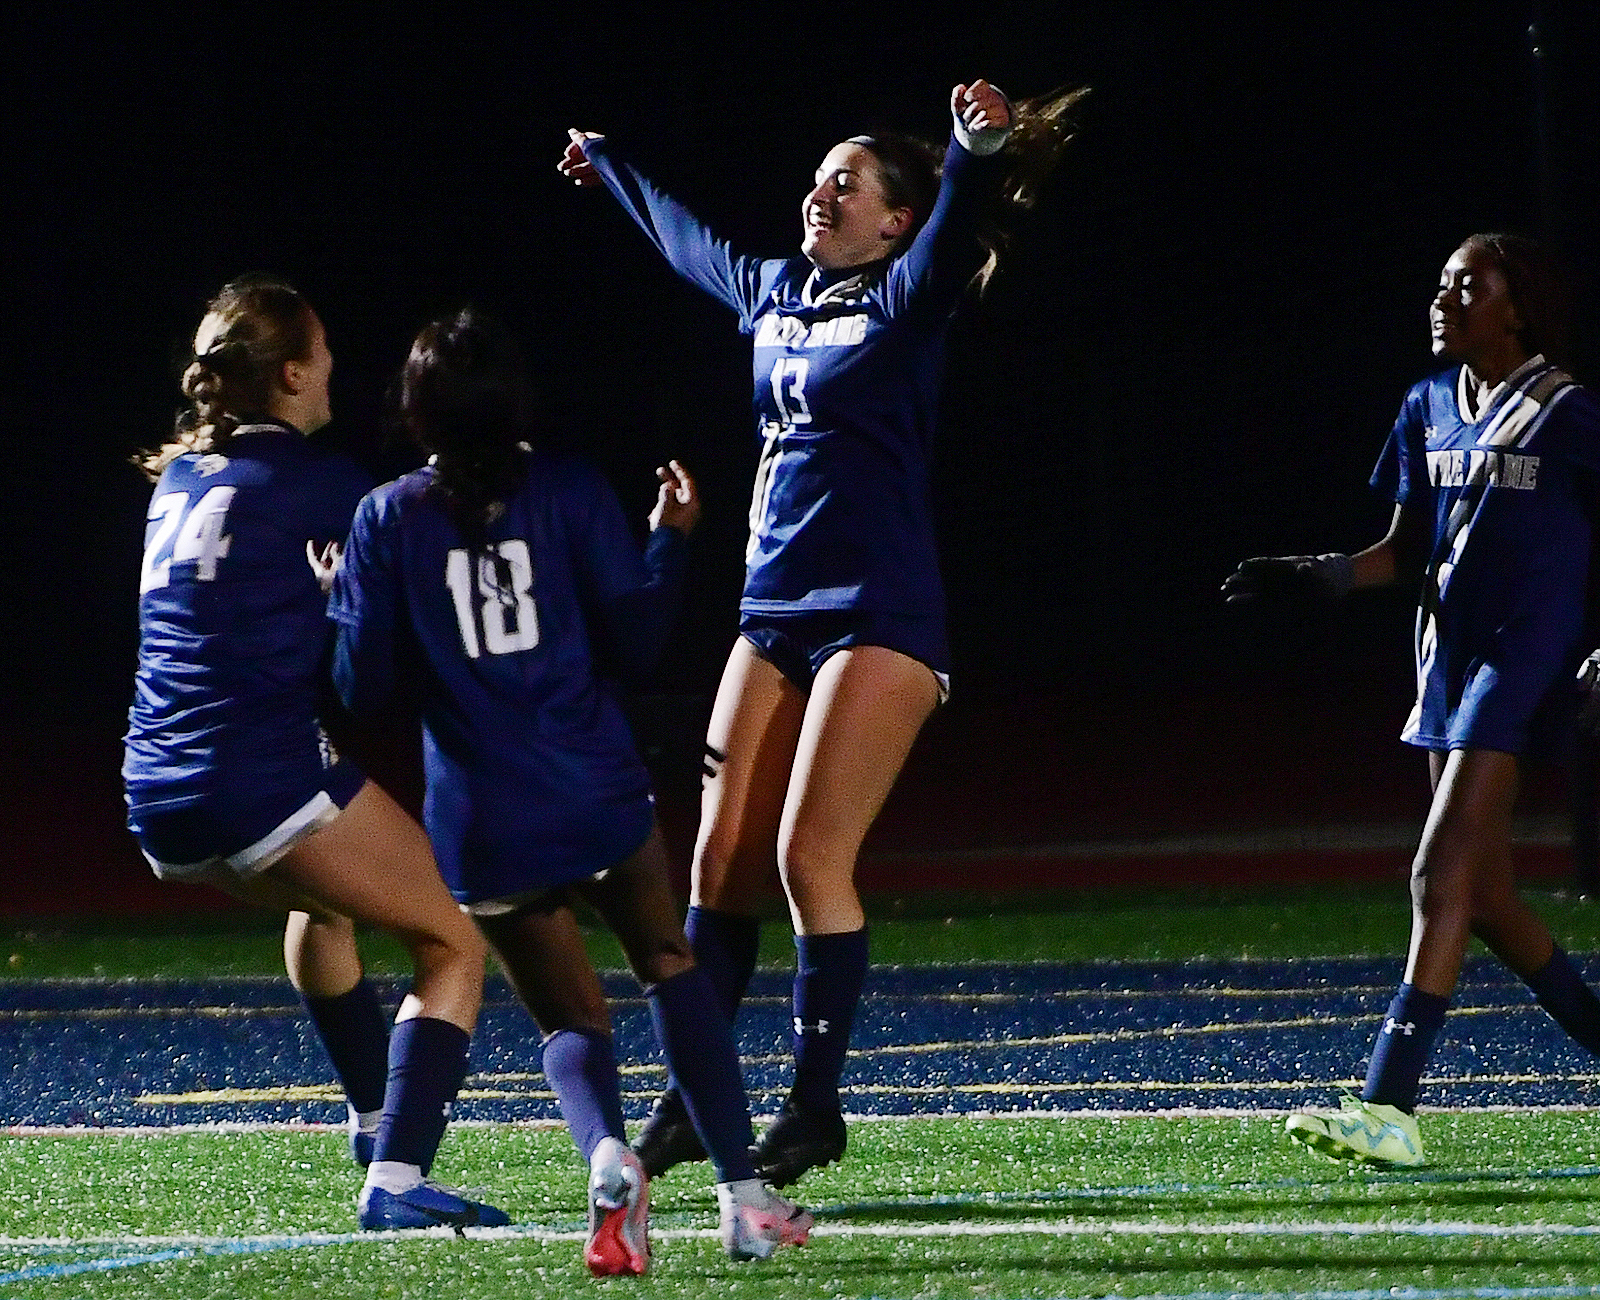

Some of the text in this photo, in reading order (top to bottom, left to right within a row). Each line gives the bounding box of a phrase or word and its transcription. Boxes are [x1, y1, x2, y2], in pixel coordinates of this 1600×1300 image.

[770, 358, 812, 424] 13
[139, 485, 238, 596] 24
[445, 538, 540, 660] 18
